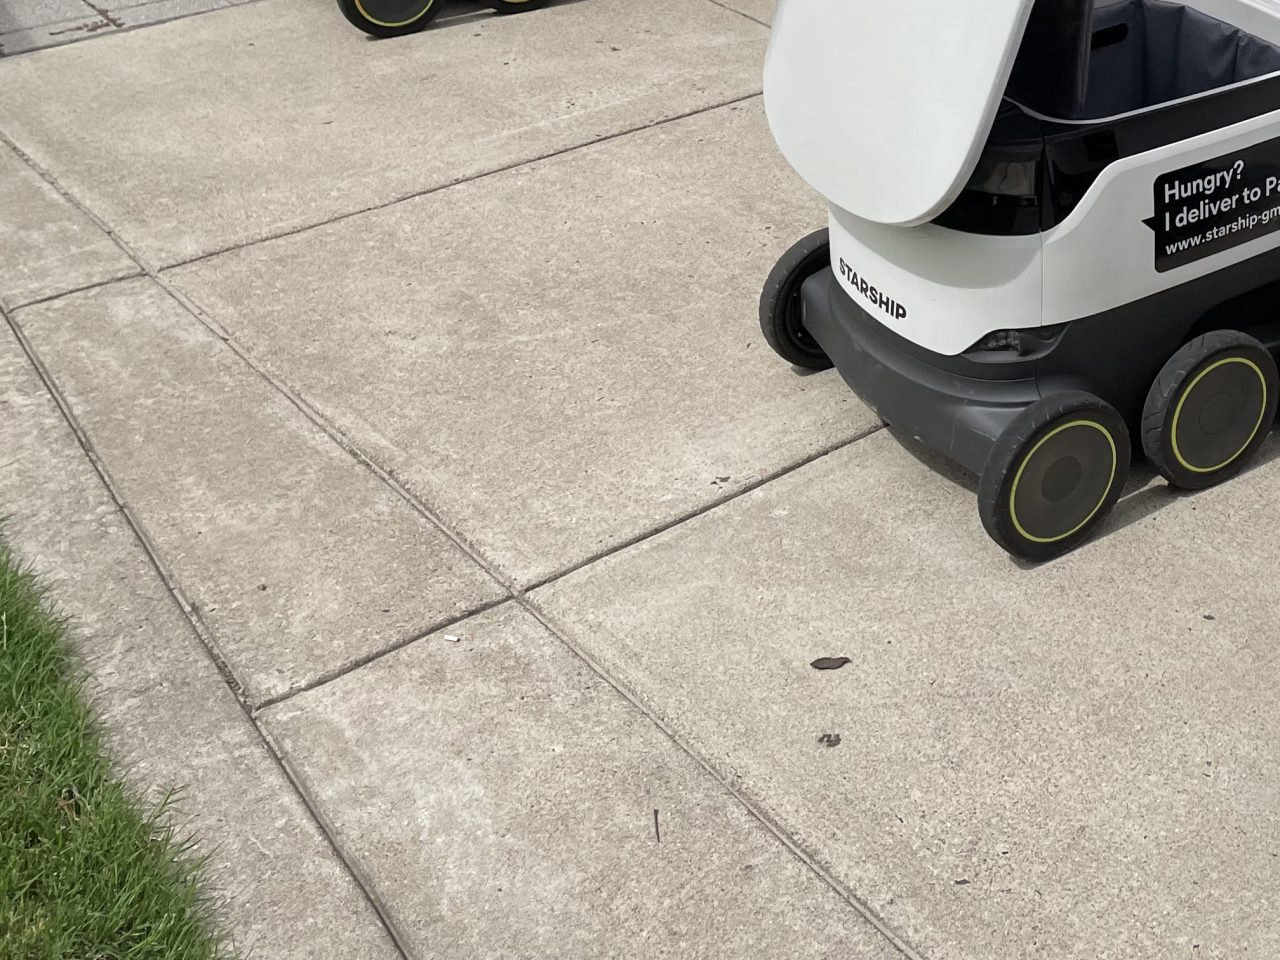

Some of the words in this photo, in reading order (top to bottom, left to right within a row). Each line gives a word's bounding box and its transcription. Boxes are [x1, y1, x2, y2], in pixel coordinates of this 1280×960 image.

[1164, 159, 1245, 204] Hungry?
[1164, 212, 1170, 231] I
[1175, 193, 1239, 228] deliver
[1242, 186, 1261, 204] to
[840, 257, 907, 320] STARSHIP
